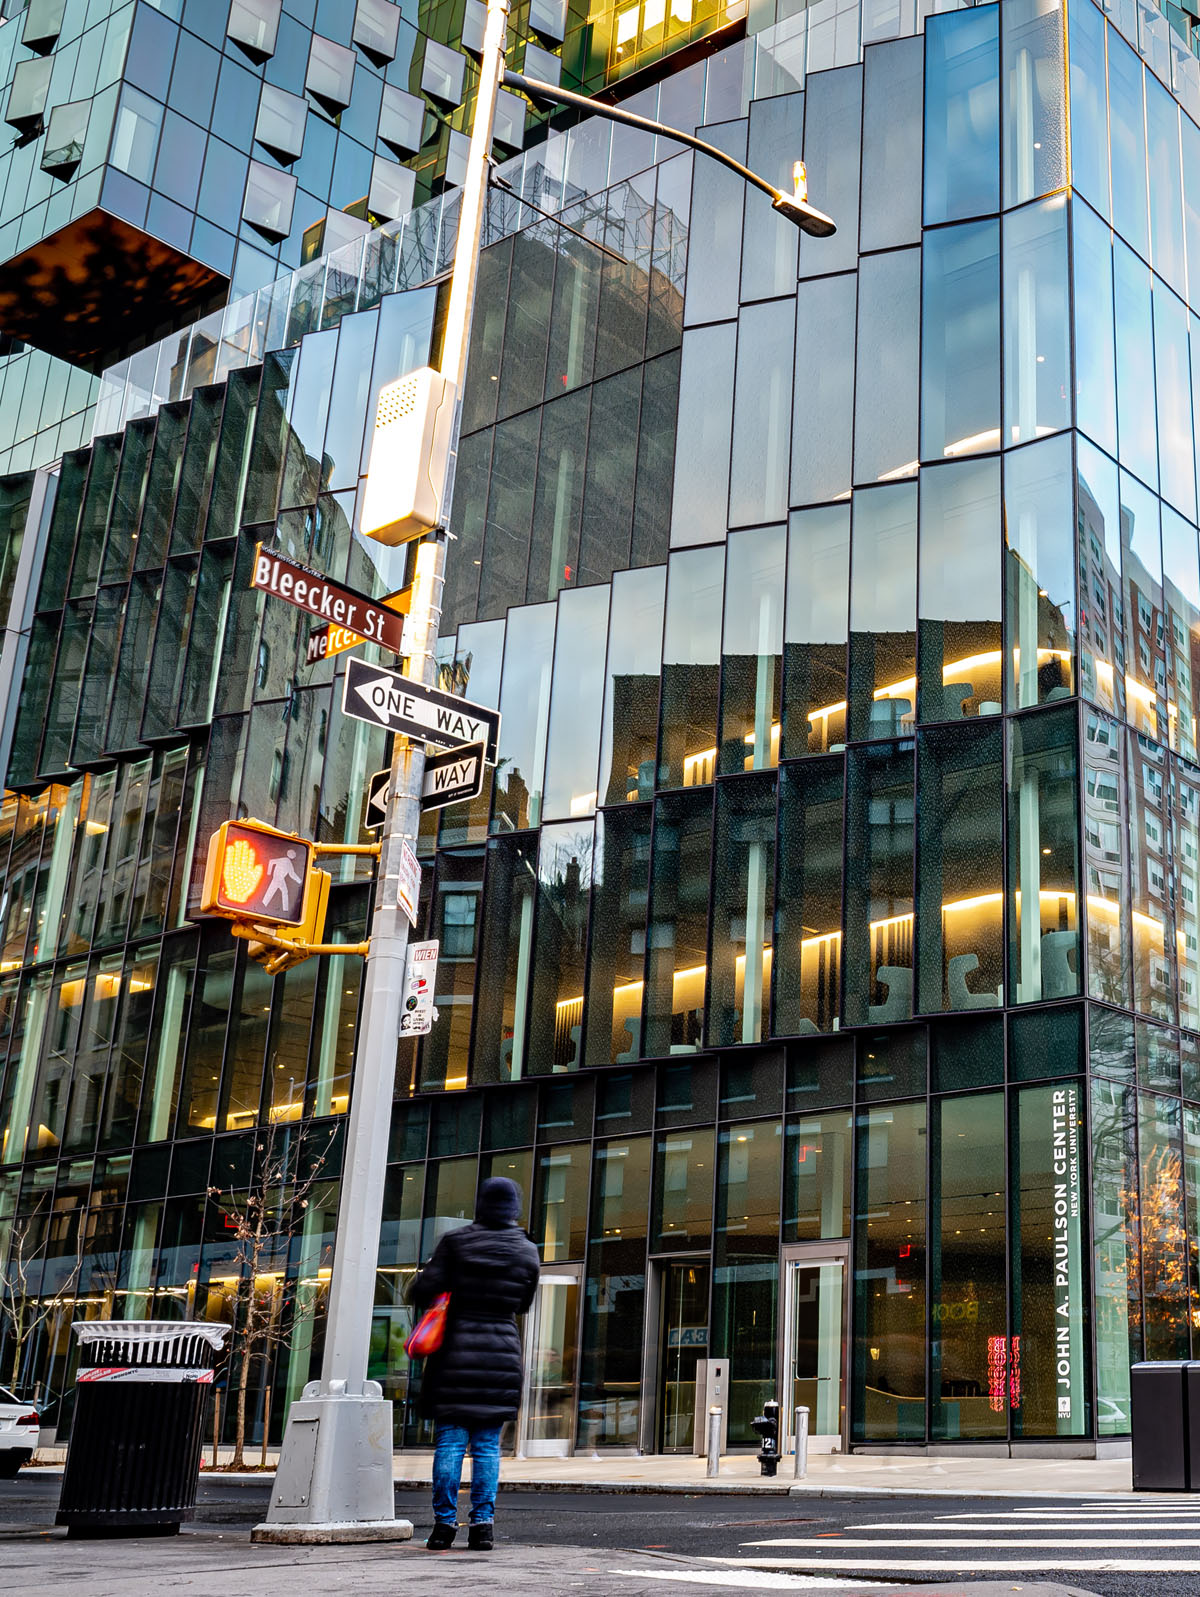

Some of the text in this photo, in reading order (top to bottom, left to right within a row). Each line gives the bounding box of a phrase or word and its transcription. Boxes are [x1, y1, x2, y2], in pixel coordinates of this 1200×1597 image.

[255, 556, 385, 641] Bleecker St
[372, 686, 480, 740] ONE WAY
[435, 761, 472, 791] WAY
[414, 949, 438, 960] WIEN
[1068, 1089, 1076, 1154] UNIVERSITY
[1053, 1090, 1071, 1389] JOHN A. PAULSON CENTER
